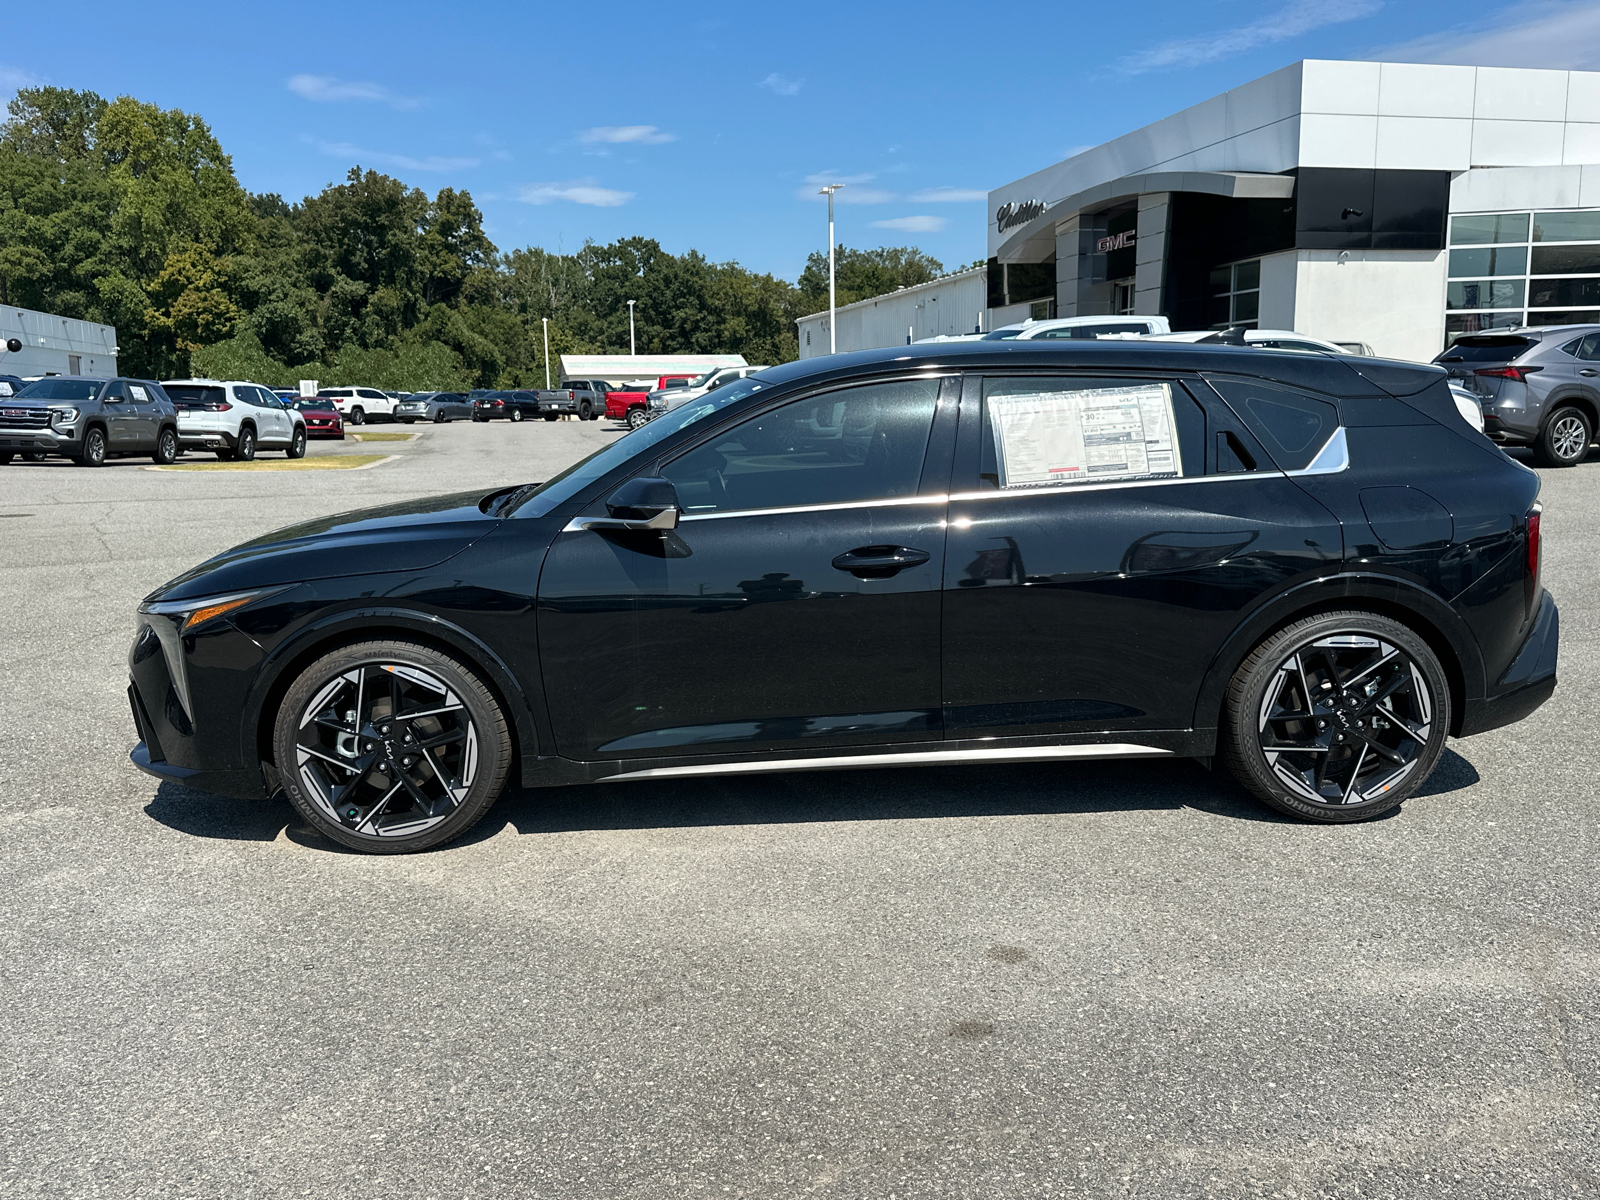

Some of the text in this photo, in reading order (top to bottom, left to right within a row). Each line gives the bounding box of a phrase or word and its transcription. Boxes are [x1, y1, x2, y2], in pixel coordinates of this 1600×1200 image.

[996, 198, 1048, 234] Cadillac
[1097, 229, 1136, 253] GMC
[290, 784, 328, 829] KUMHO
[1283, 795, 1335, 818] KUMHO
